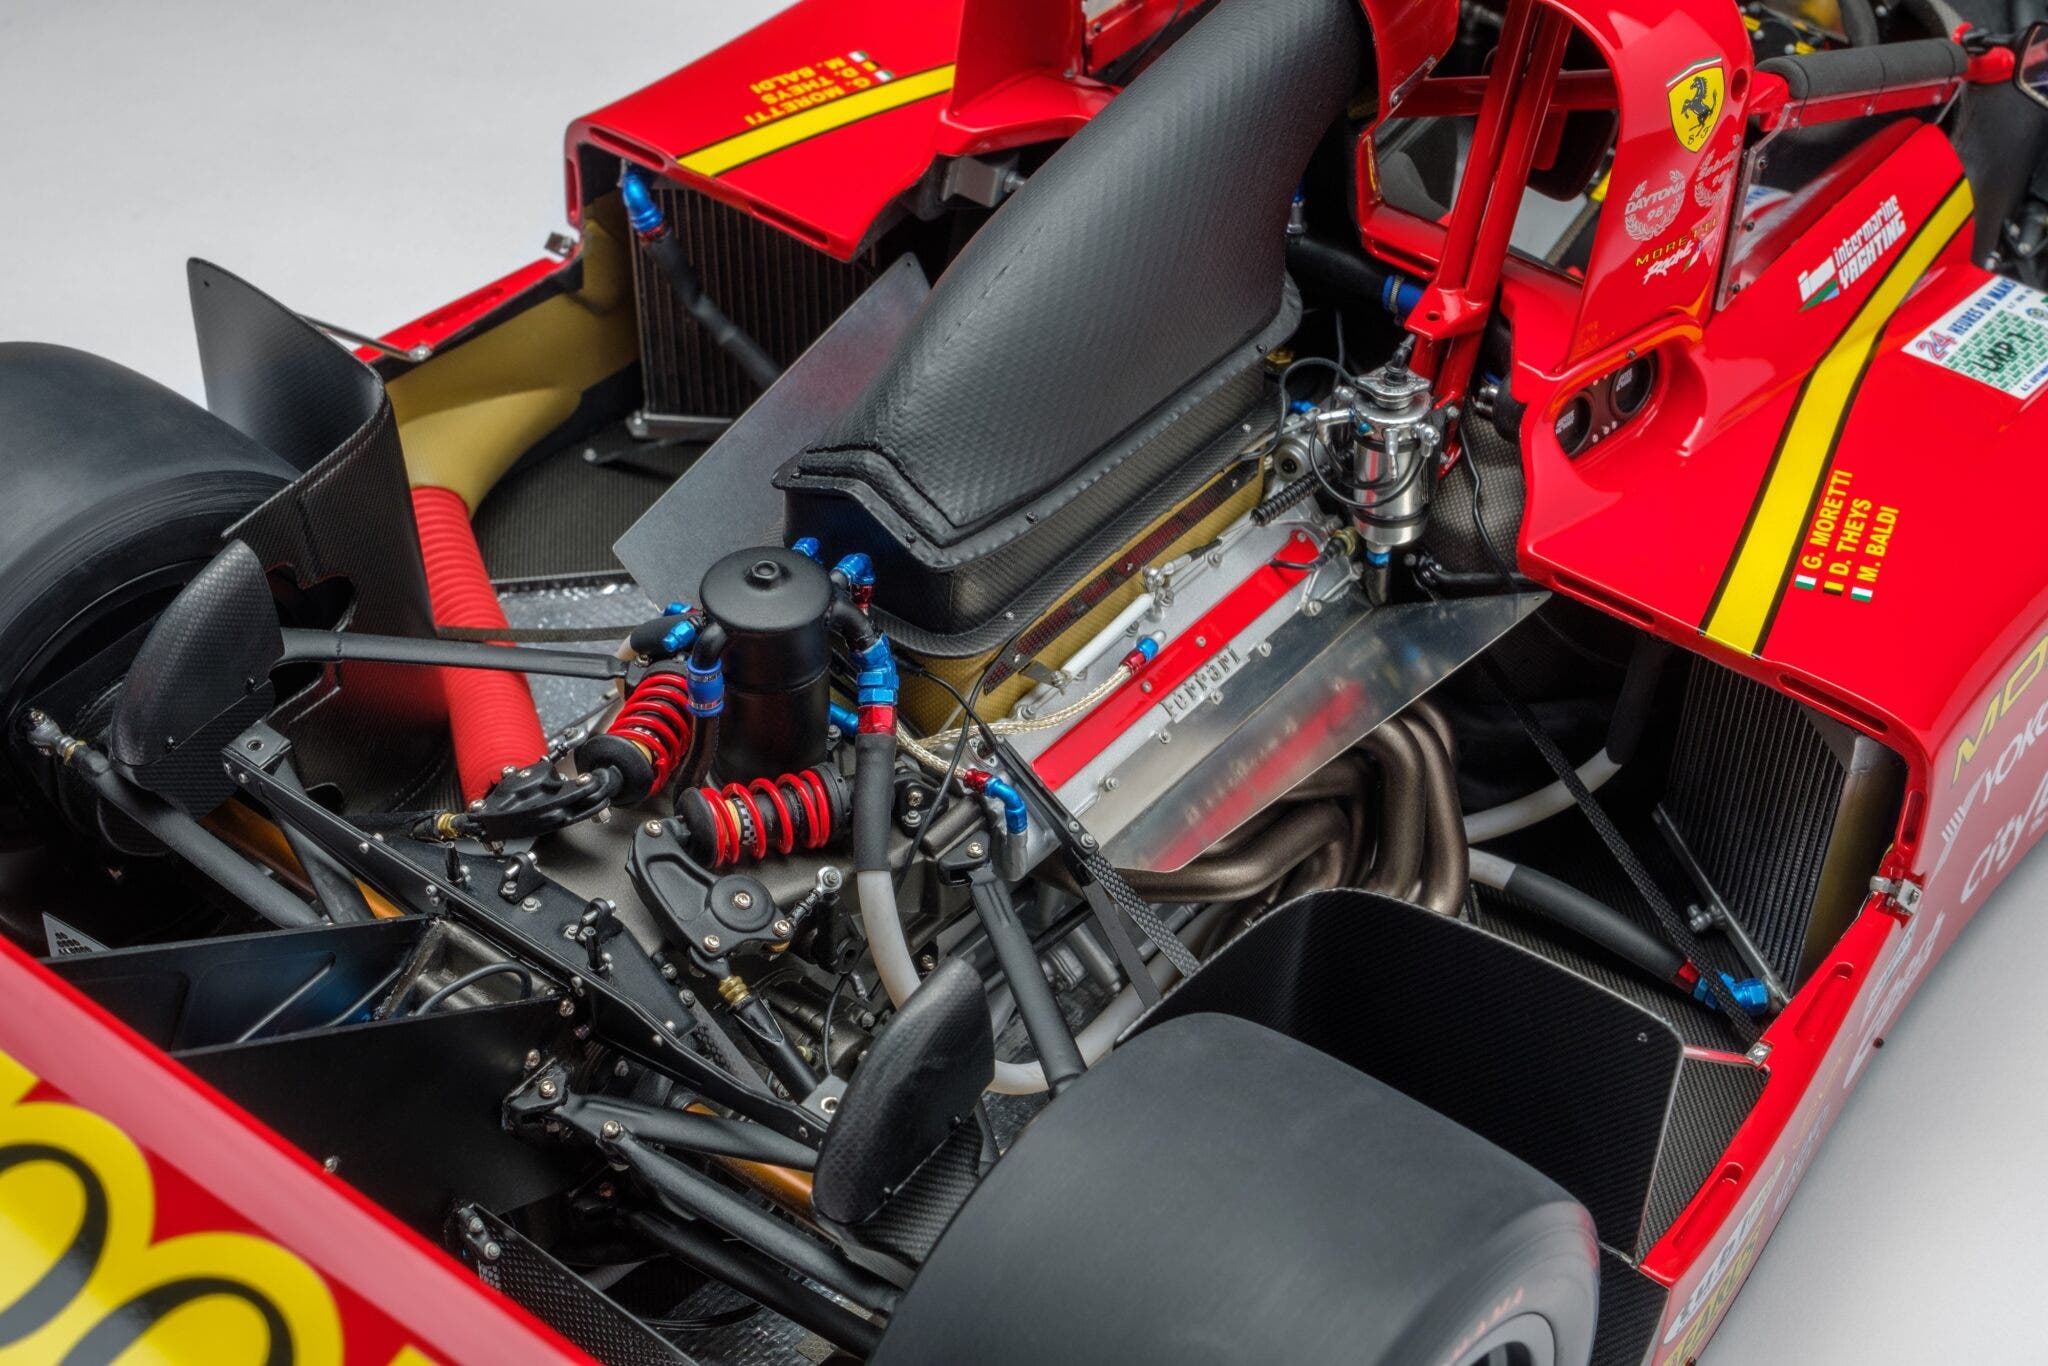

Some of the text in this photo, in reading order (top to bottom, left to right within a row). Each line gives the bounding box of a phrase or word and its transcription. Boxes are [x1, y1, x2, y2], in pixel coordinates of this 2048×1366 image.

[744, 86, 846, 125] MORETTI
[750, 66, 816, 94] BALDI
[760, 76, 835, 105] THEYS
[1624, 180, 1686, 216] DAYTONA
[1647, 206, 1665, 222] 98
[1635, 217, 1717, 268] MORETTI
[1832, 194, 1899, 269] intermarine
[1838, 210, 1907, 290] YACHTING
[1915, 330, 1958, 361] 24
[1946, 306, 1986, 336] HEURES
[1974, 297, 1998, 312] DU
[1801, 469, 1854, 570] G. MORETTI
[1828, 498, 1873, 577] D. THEYS
[1856, 505, 1900, 583] M. BALDI
